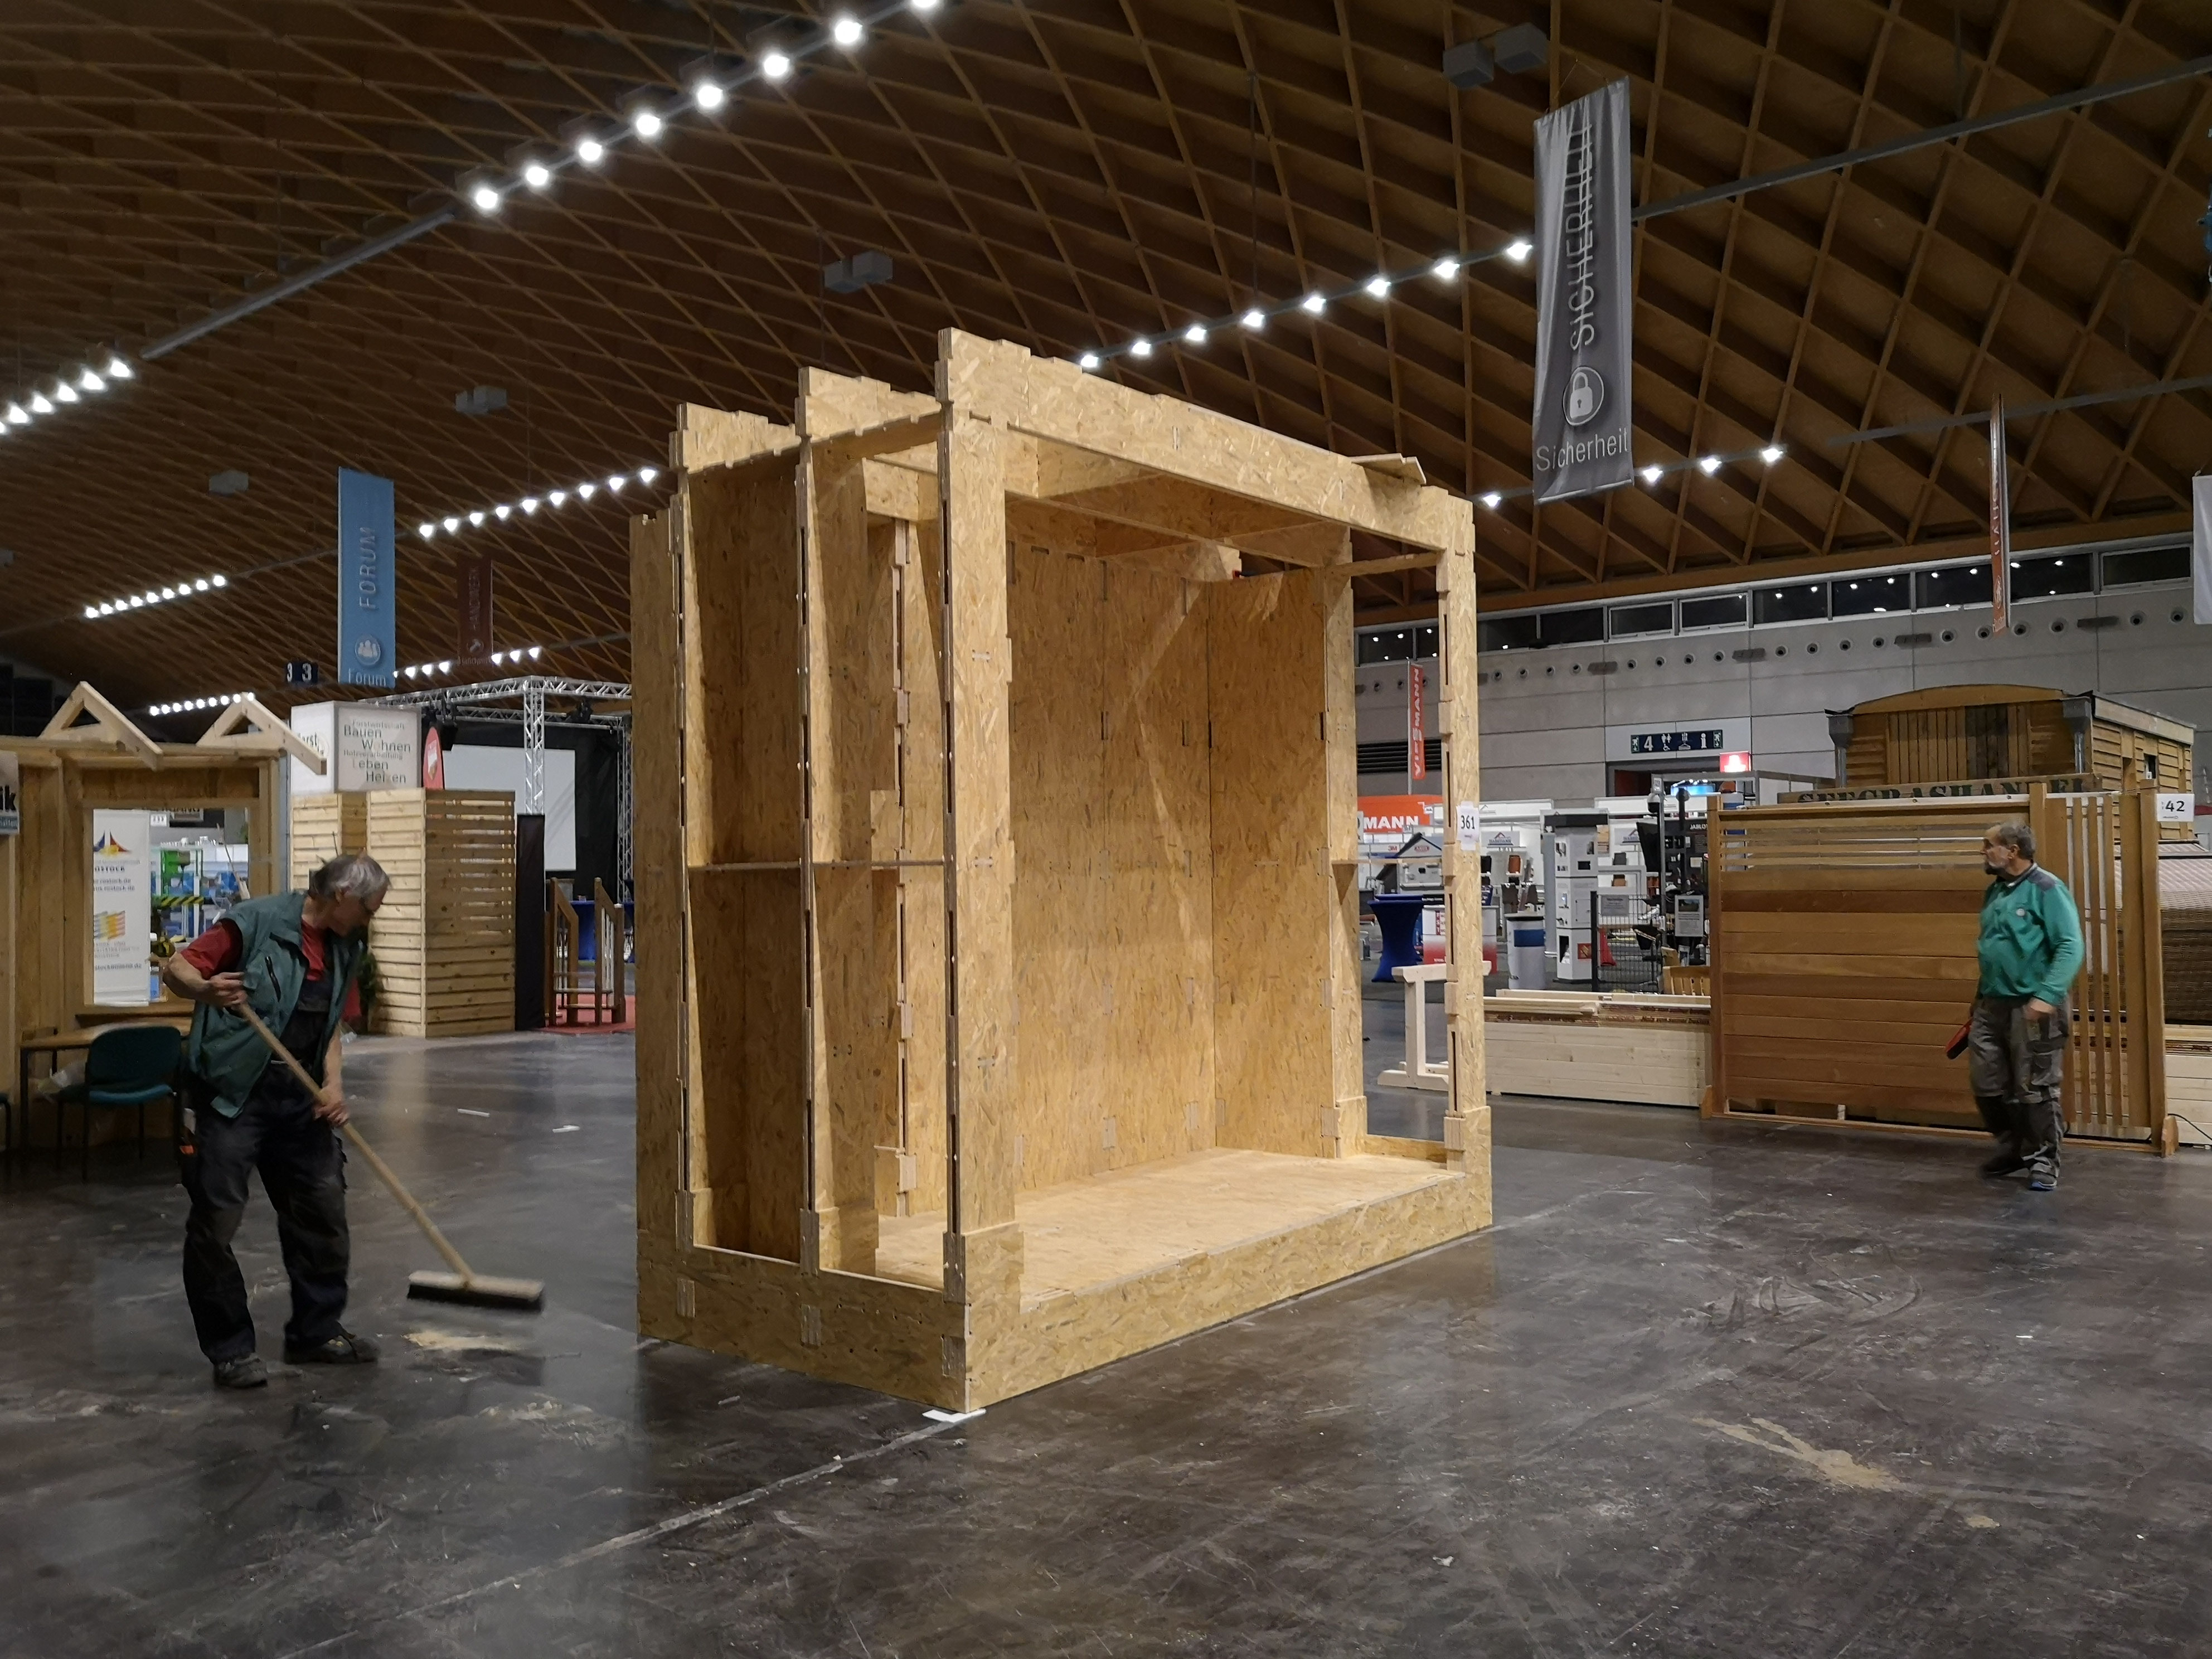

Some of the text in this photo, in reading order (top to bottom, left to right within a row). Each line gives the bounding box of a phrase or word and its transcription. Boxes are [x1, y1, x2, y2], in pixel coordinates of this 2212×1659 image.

[1536, 427, 1629, 472] Sicherheit
[359, 527, 377, 610] FORUM
[302, 662, 312, 682] 3
[348, 668, 386, 687] Forum
[344, 724, 382, 738] Bauen
[1643, 735, 1653, 751] 4
[366, 770, 406, 784] Heien
[1461, 815, 1475, 830] 361
